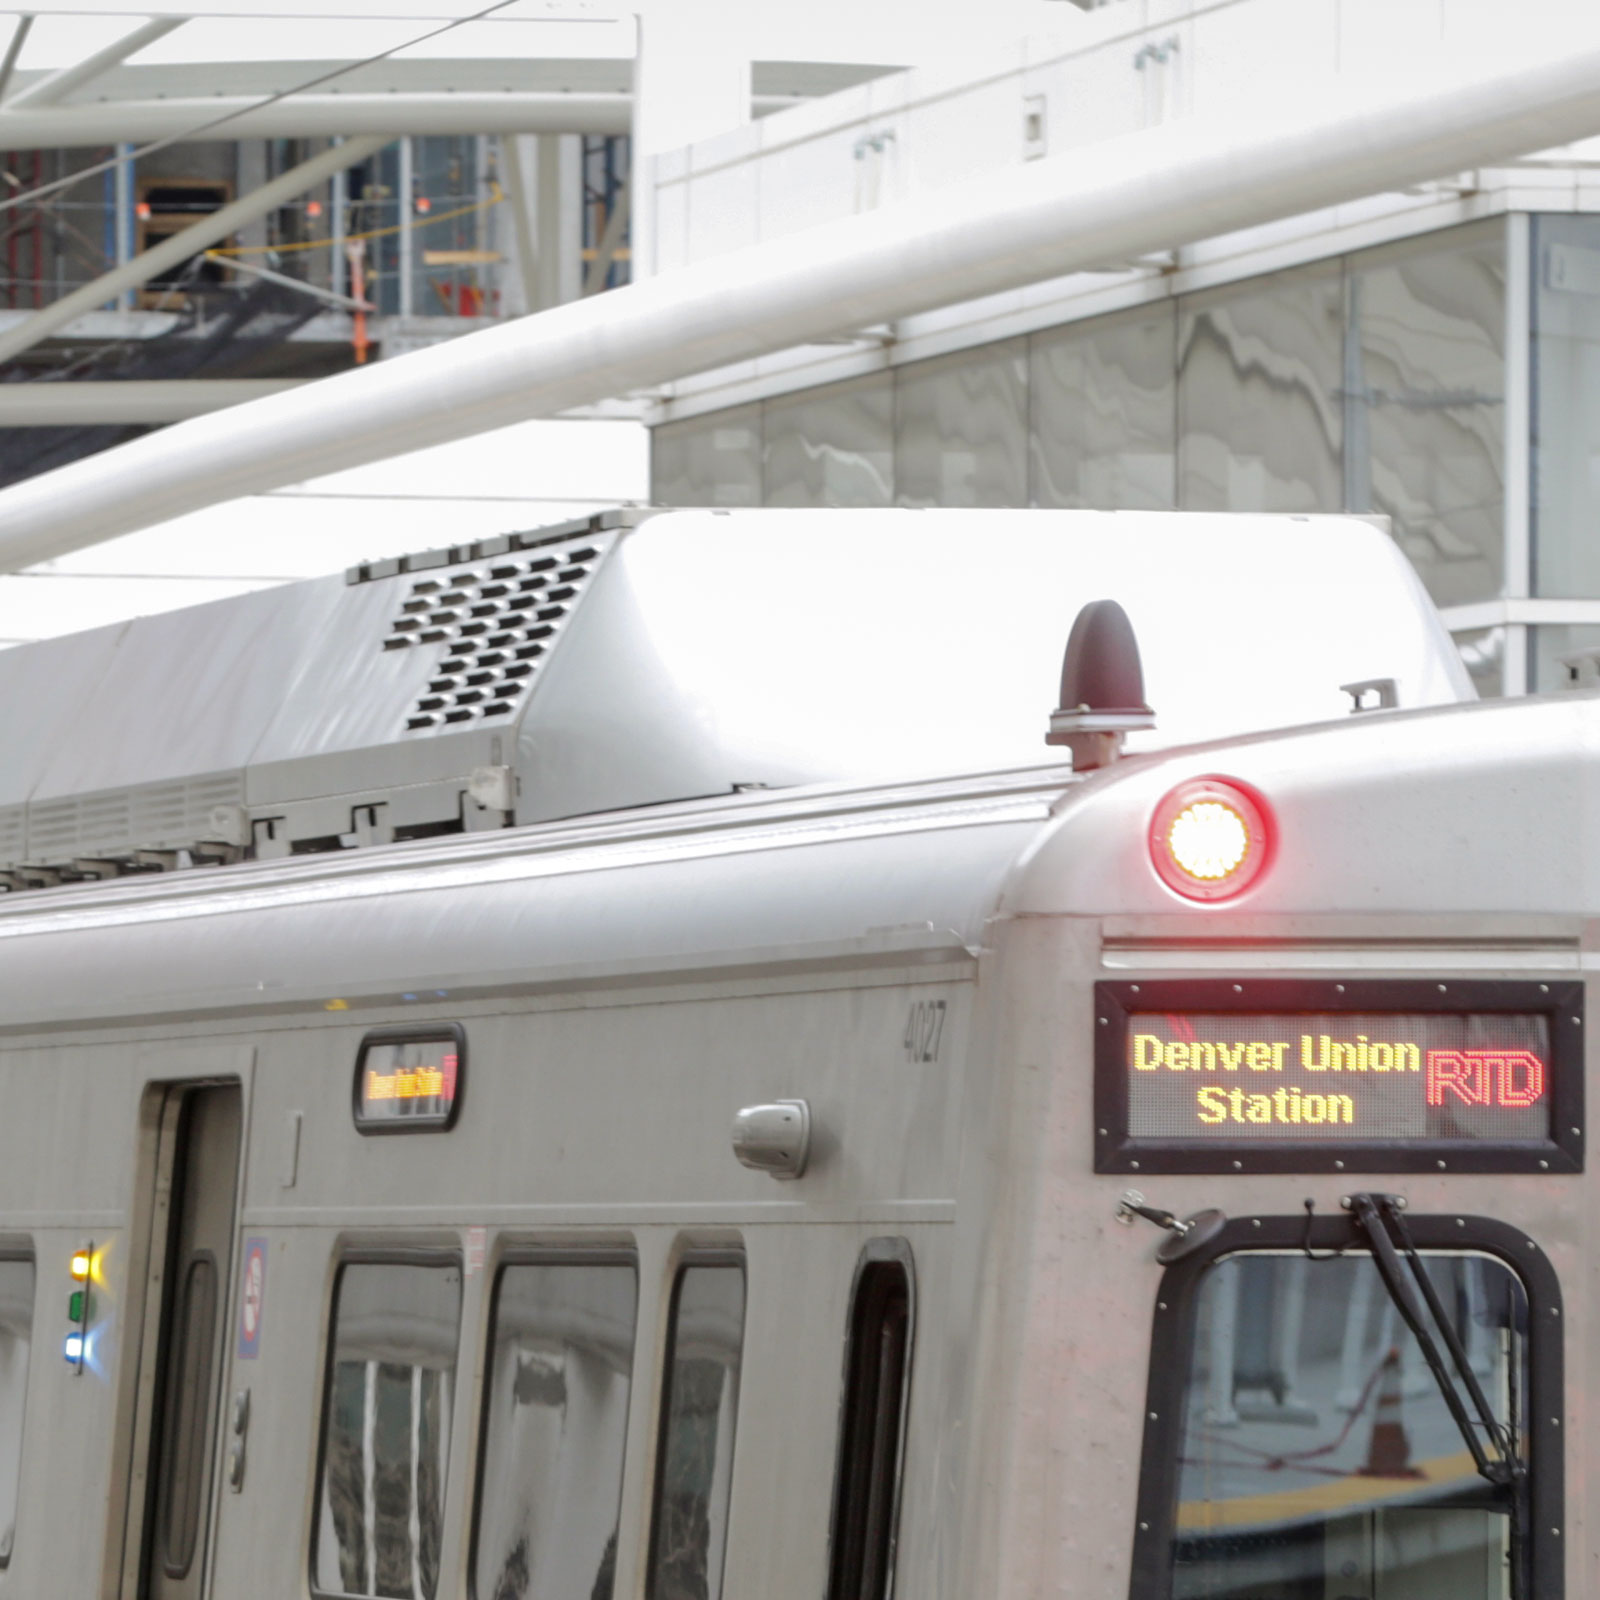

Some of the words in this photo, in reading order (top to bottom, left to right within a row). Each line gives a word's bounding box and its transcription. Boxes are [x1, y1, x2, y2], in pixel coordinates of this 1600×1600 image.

[1133, 1034, 1289, 1071] Denver
[1301, 1034, 1420, 1071] Union
[1426, 1050, 1544, 1106] RTD
[1197, 1086, 1354, 1123] Station
